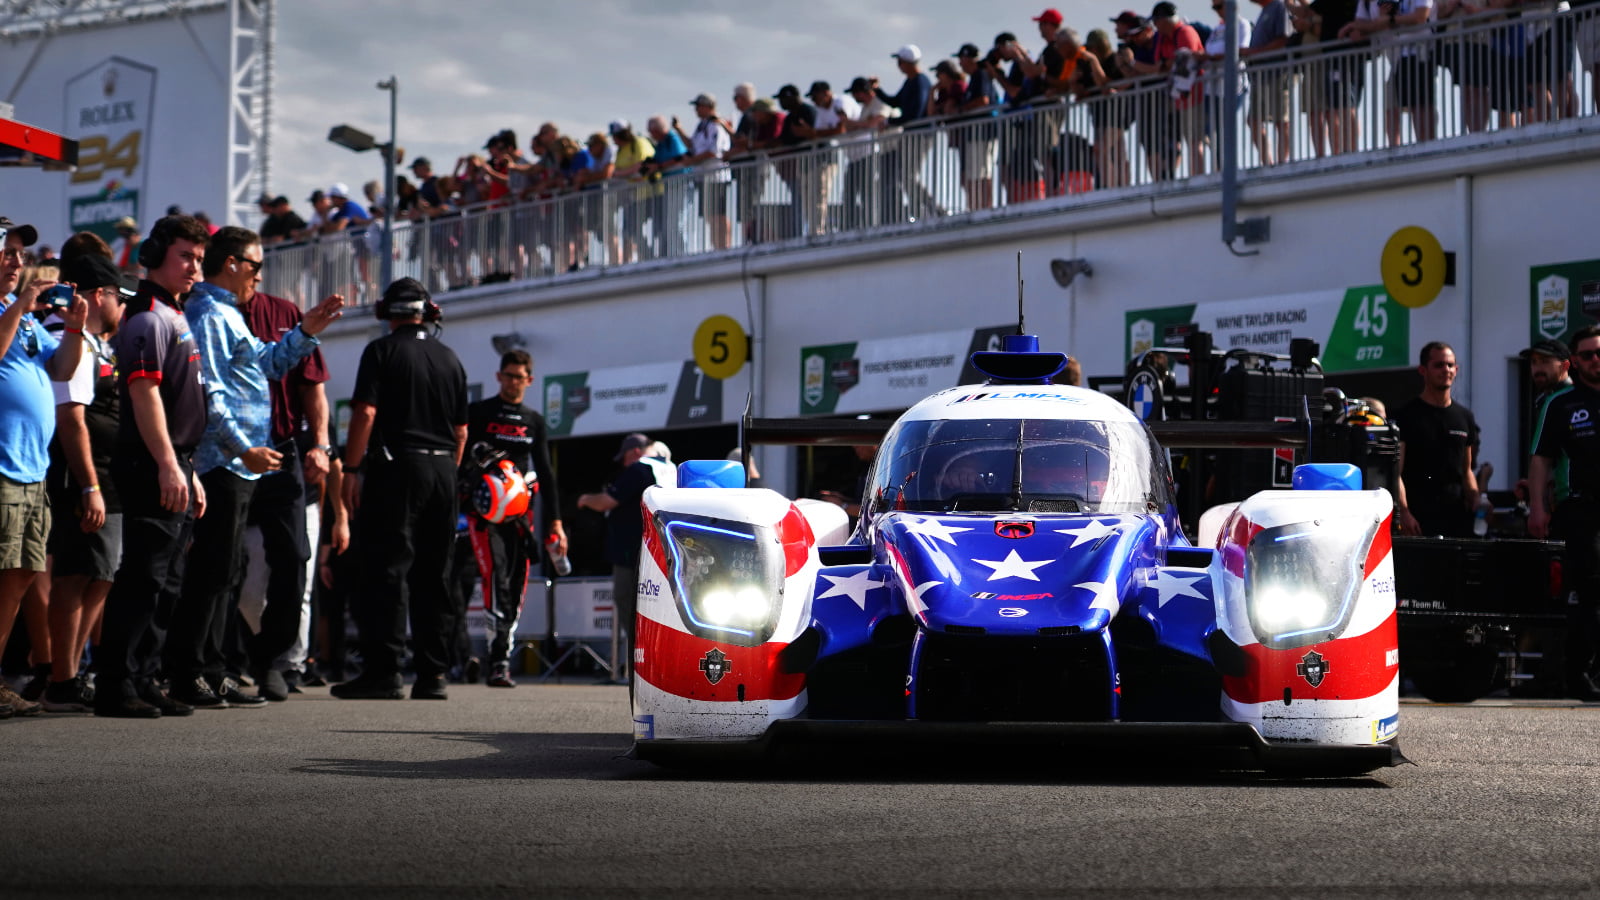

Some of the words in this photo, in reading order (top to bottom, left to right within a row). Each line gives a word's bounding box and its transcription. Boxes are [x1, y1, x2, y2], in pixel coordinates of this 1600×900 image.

[80, 102, 135, 128] ROLEX
[70, 130, 143, 184] 24
[1401, 244, 1424, 287] 3
[1215, 314, 1244, 330] WAYNE
[1245, 312, 1275, 328] TAYLOR
[1276, 308, 1307, 324] RACING
[1354, 294, 1388, 338] 45
[709, 331, 729, 364] 5
[1229, 332, 1251, 347] WITH
[1251, 329, 1292, 345] ANDRETTI
[1356, 345, 1383, 361] GTD
[1412, 600, 1431, 609] Team
[1433, 600, 1447, 610] RLL
